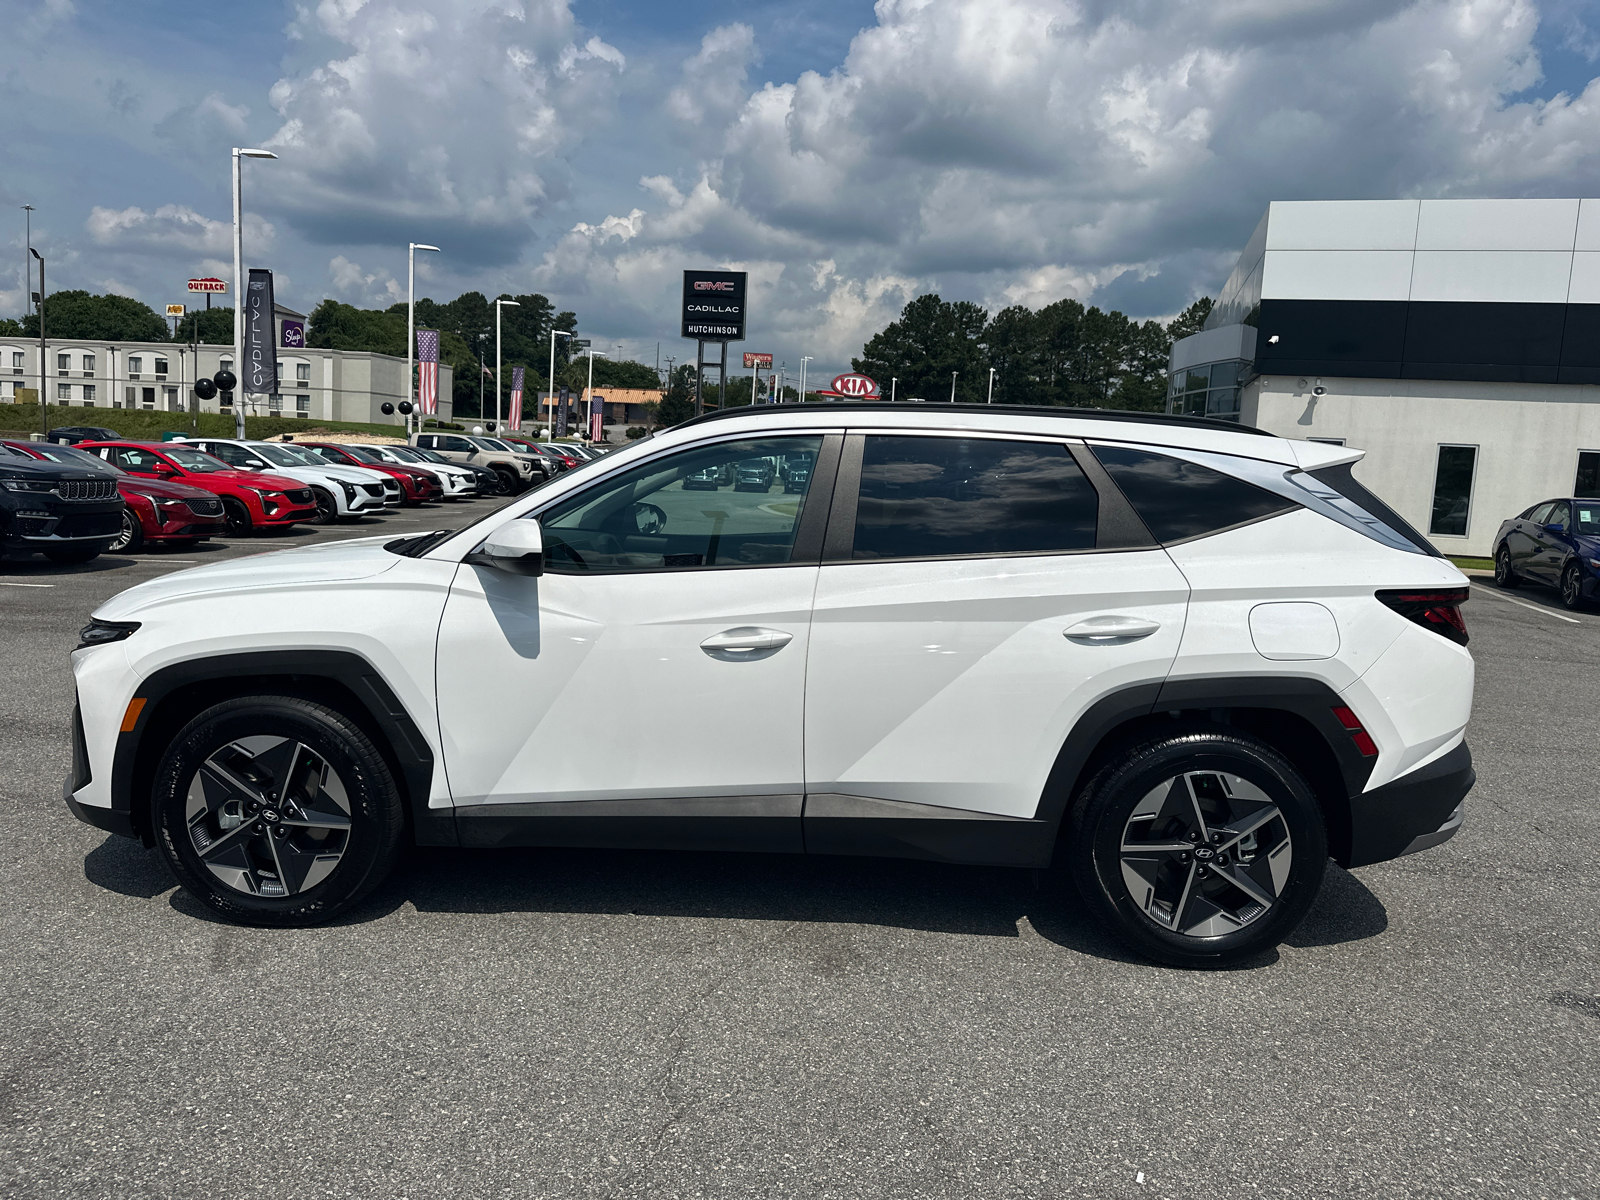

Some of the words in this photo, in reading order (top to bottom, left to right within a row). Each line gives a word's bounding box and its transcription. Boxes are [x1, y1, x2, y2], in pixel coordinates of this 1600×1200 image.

[188, 282, 225, 291] OUTBACK
[694, 281, 735, 291] GMC
[687, 304, 740, 313] CADILLAC
[688, 325, 738, 335] HUTCHINSON
[252, 296, 263, 386] CADILLAC
[840, 377, 869, 394] KIA
